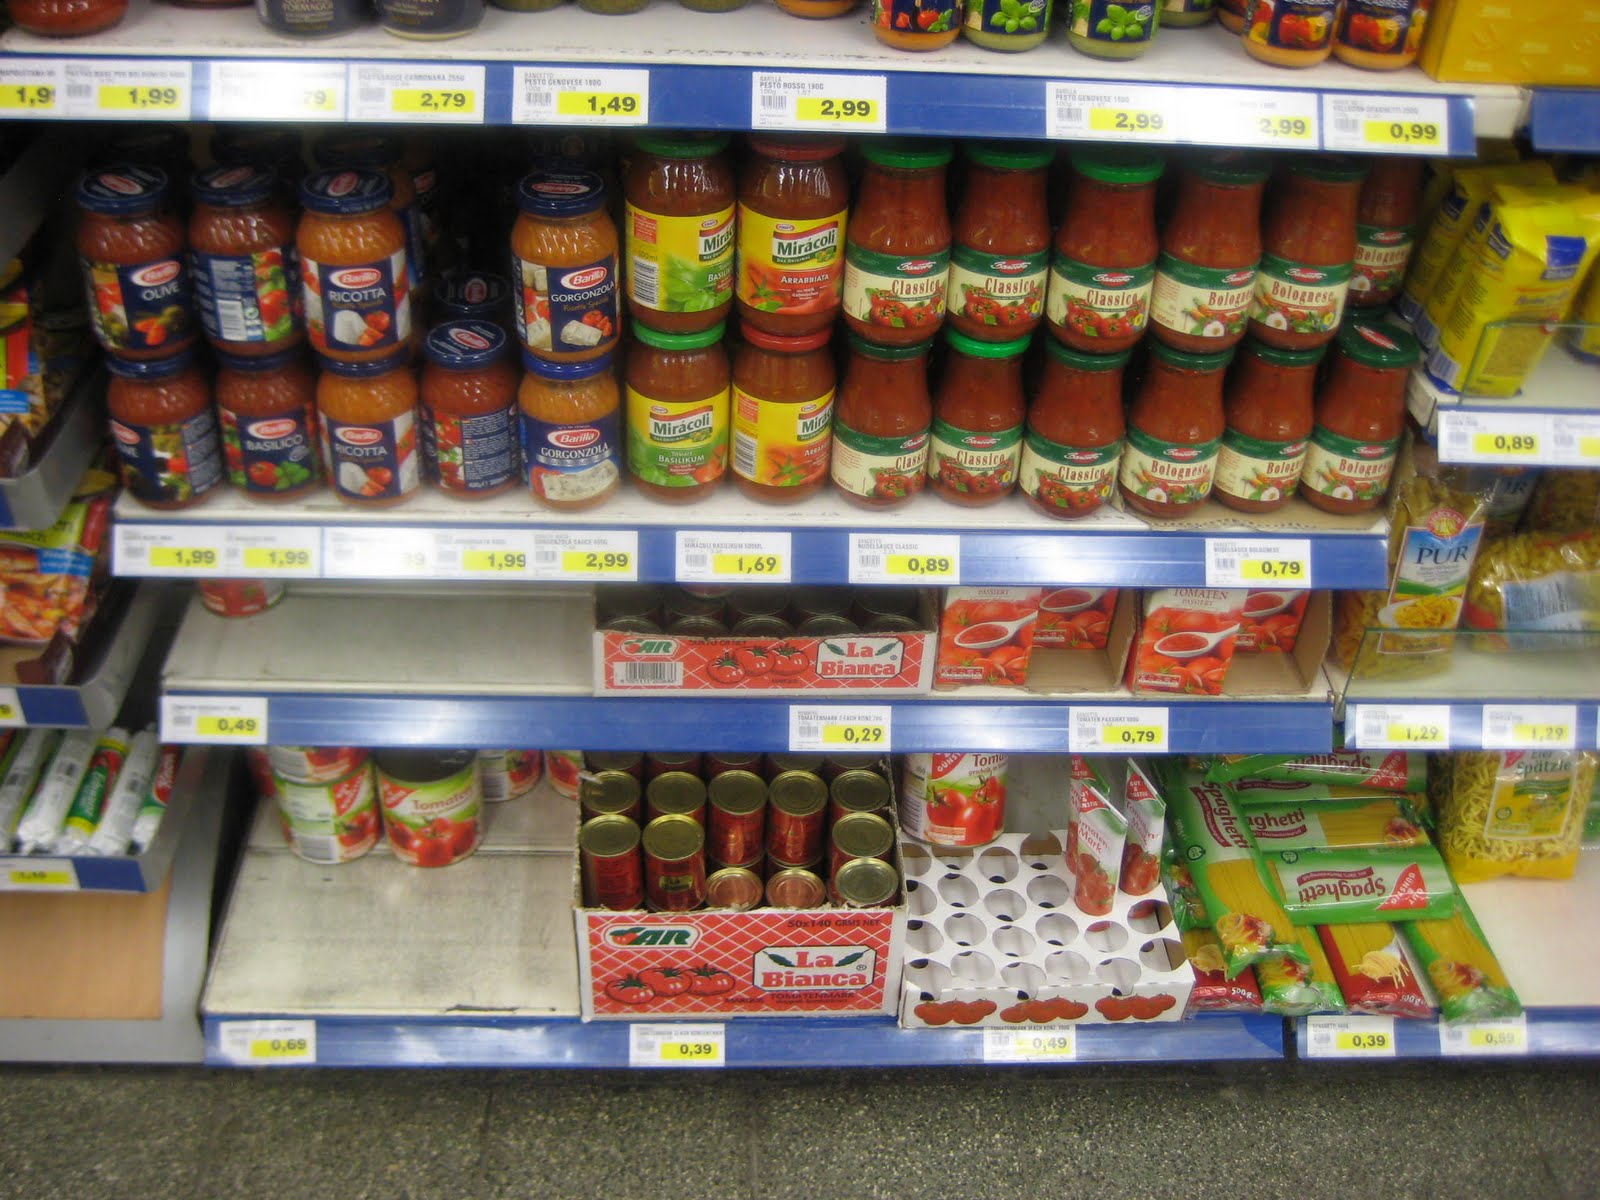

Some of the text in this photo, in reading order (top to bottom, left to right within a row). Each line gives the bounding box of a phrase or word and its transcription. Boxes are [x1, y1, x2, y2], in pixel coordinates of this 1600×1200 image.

[129, 88, 177, 107] 1,99
[420, 93, 466, 110] 2,79
[1078, 95, 1112, 103] GENOVESE
[587, 96, 637, 116] 1,49
[820, 99, 870, 119] 2,99
[1115, 113, 1165, 132] 2,99
[1259, 118, 1306, 137] 2,99
[1390, 123, 1437, 142] 0,99
[777, 229, 836, 256] Mirácoli
[572, 269, 605, 286] Barilla
[780, 273, 829, 284] ARRABBIATA
[984, 277, 1035, 294] Classico
[142, 282, 181, 302] OLIVE
[551, 280, 615, 303] GORGONZOLA
[891, 278, 940, 296] Classico
[1271, 280, 1335, 304] Bolognese
[329, 288, 387, 303] RICOTTA
[1086, 289, 1139, 307] Classico
[653, 412, 711, 436] Mirácoli
[247, 434, 303, 451] BASILICO
[560, 432, 596, 444] Barilla
[1495, 436, 1535, 452] 0,89
[335, 443, 388, 457] RICOTTA
[541, 442, 609, 460] GORGONZOLA
[956, 450, 1006, 466] Classico
[658, 454, 706, 464] BASILIKUM
[1057, 466, 1107, 482] Classico
[1151, 459, 1209, 478] Bolognese
[175, 551, 215, 567] 1,99
[269, 552, 309, 568] 1,99
[488, 553, 527, 571] 1,99
[585, 553, 629, 570] 2,99
[1416, 545, 1469, 565] PUR
[738, 556, 777, 574] 1,69
[908, 558, 950, 574] 0,89
[1261, 561, 1301, 577] 0,79
[1174, 588, 1229, 600] TOMATEN
[846, 642, 874, 658] La
[820, 661, 896, 677] Bianca
[217, 719, 257, 733] 0,49
[844, 728, 882, 743] 0,29
[1122, 731, 1155, 744] 0,79
[1406, 728, 1438, 741] 1,29
[1531, 728, 1564, 742] 1,29
[1517, 760, 1572, 778] Spätzle
[1298, 877, 1387, 907] Spaghetti
[787, 918, 881, 928] 50x140 GRMS NET
[795, 951, 834, 968] La
[761, 971, 867, 988] Bianca
[770, 992, 855, 1000] TOMATENMARK
[271, 1038, 307, 1052] 0,69
[680, 1043, 712, 1056] 0,39
[1032, 1037, 1068, 1052] 0,49
[1352, 1034, 1386, 1049] 0,39
